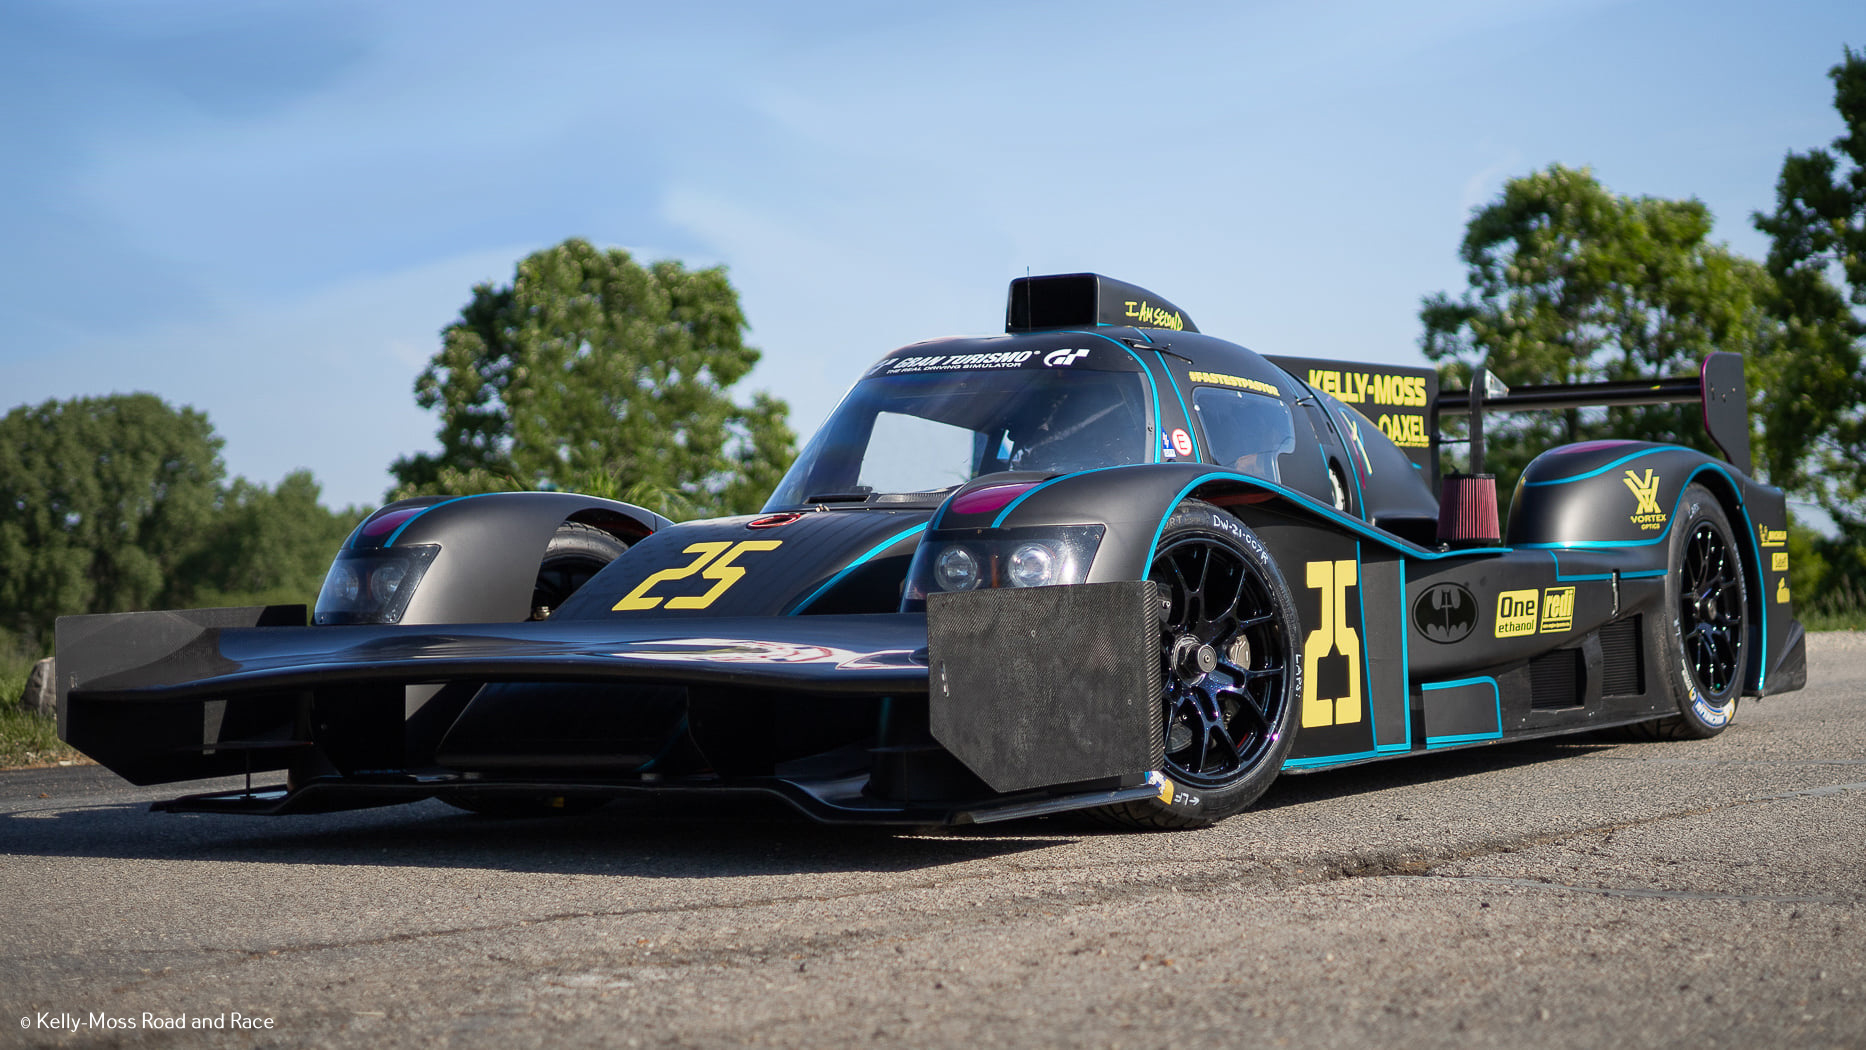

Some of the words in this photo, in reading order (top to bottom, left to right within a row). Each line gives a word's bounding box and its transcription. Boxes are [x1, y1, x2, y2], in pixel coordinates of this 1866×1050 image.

[1124, 301, 1139, 317] I
[893, 356, 938, 369] GRAN
[900, 366, 922, 374] REAL
[1308, 369, 1427, 407] KELLY-MOSS
[1176, 434, 1188, 450] E
[1630, 514, 1667, 524] VORTEX
[611, 540, 783, 611] 25
[1501, 596, 1535, 618] One
[1498, 619, 1535, 633] ethanol
